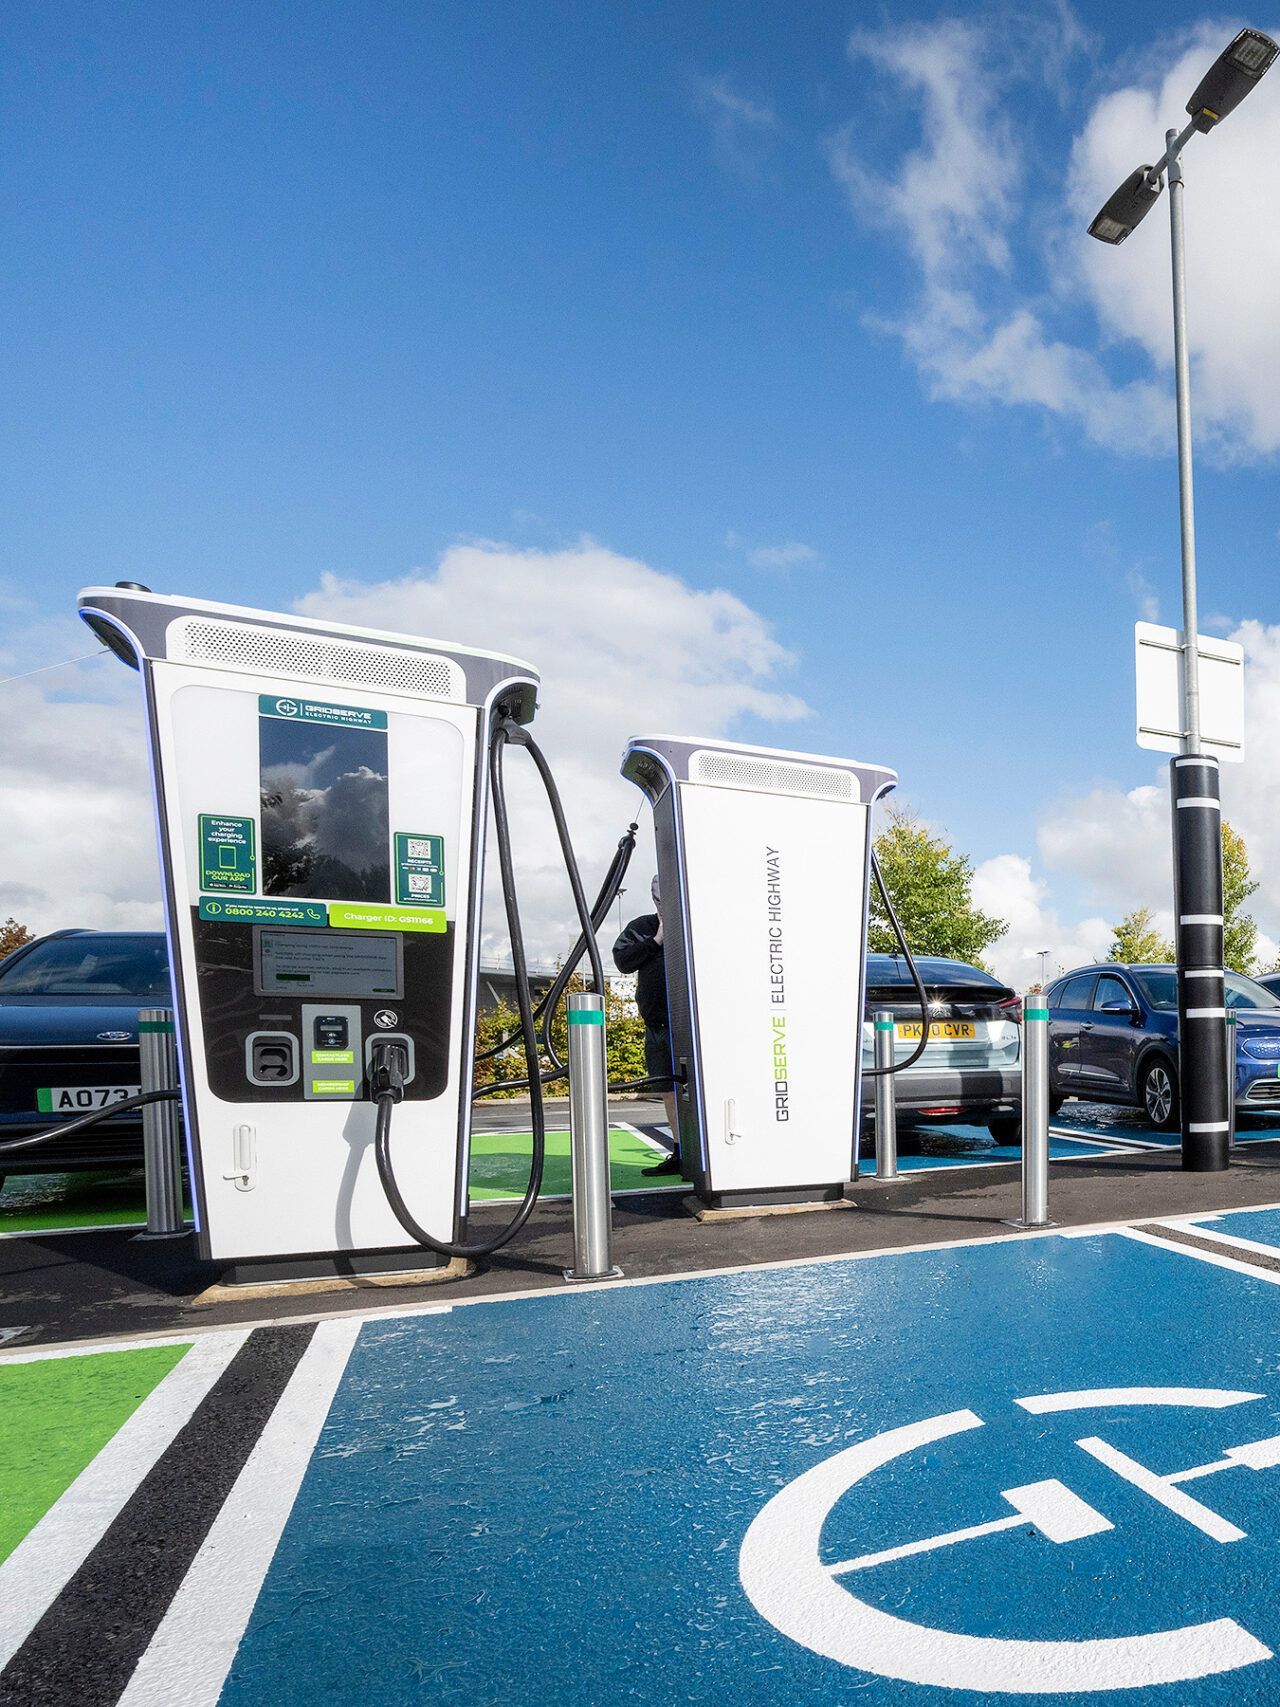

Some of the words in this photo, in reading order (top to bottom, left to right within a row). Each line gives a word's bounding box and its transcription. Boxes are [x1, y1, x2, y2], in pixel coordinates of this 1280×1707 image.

[304, 704, 372, 719] GRIDSERVE
[304, 711, 339, 721] ELECTRIC
[341, 716, 372, 725] HIGHWAY
[211, 820, 243, 828] Enhance
[211, 831, 243, 839] charging
[207, 837, 247, 845] experience
[206, 870, 251, 878] DOWNLOAD
[766, 846, 782, 922] HIGHWAY
[225, 908, 254, 916] 0800
[256, 909, 276, 917] 240
[278, 910, 305, 919] 4242
[344, 912, 382, 922] Charger
[769, 927, 785, 1003] ELECTRIC
[903, 1024, 940, 1036] PK0
[944, 1024, 969, 1036] CVR
[772, 1016, 789, 1122] GRIDSERVE
